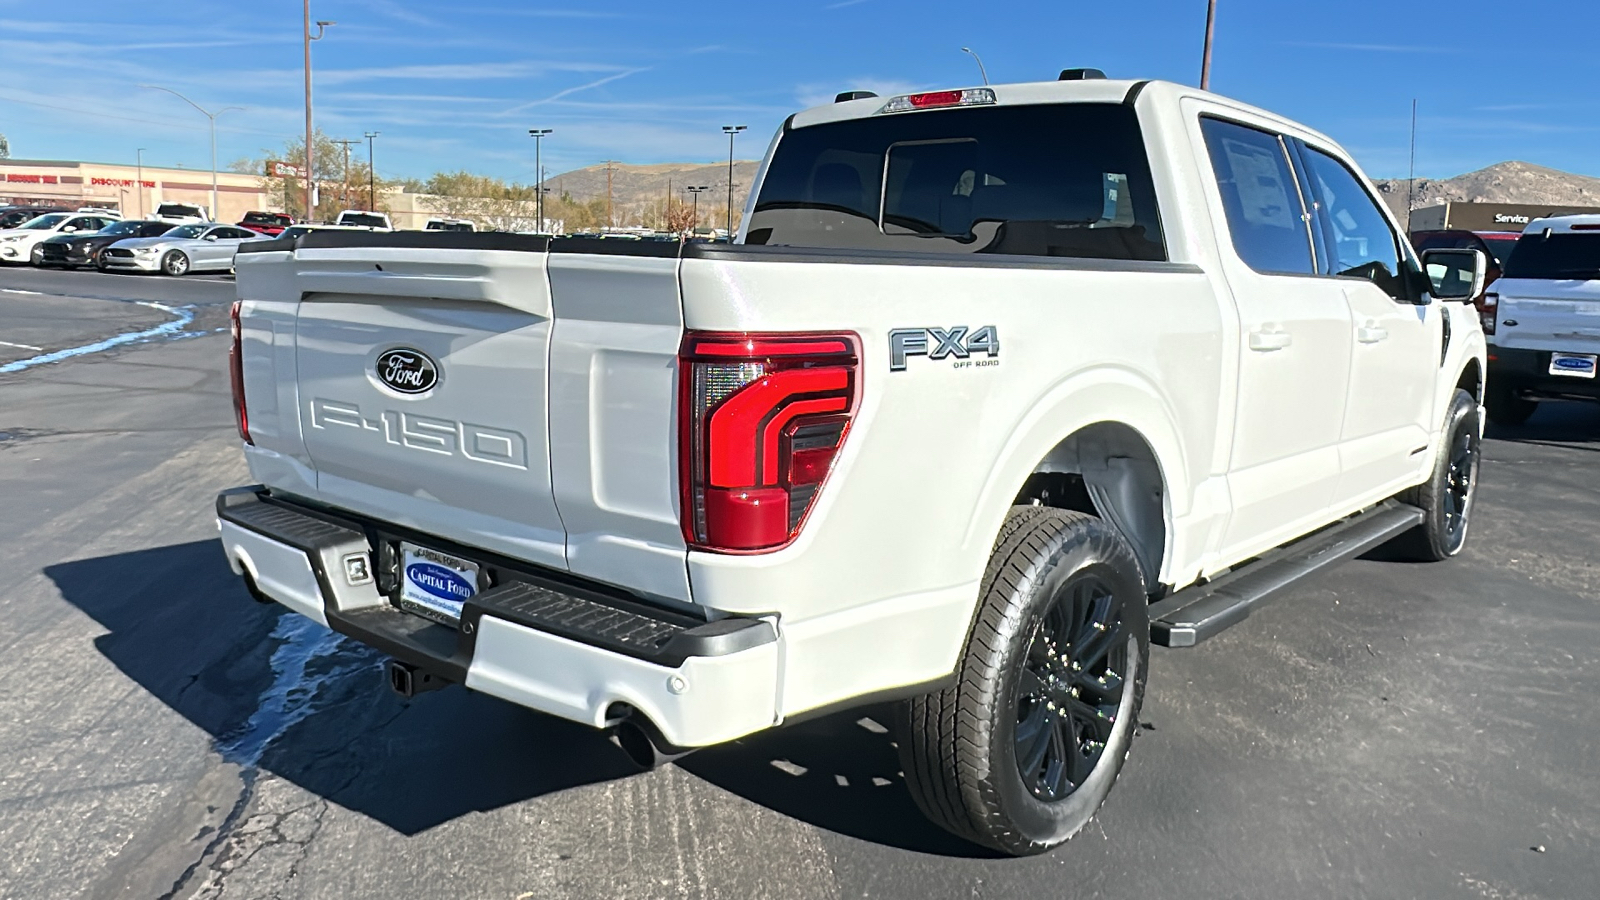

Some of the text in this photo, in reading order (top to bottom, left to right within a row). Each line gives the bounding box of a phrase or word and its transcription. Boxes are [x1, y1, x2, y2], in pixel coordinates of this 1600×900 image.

[91, 177, 156, 188] DISCOUNT TIRE
[1495, 213, 1529, 224] Service
[888, 325, 999, 373] FX4
[953, 360, 999, 369] OFF ROAD
[385, 354, 424, 387] Ford
[310, 397, 528, 471] F-150
[410, 567, 446, 591] CAPITAL
[447, 579, 471, 599] FORD
